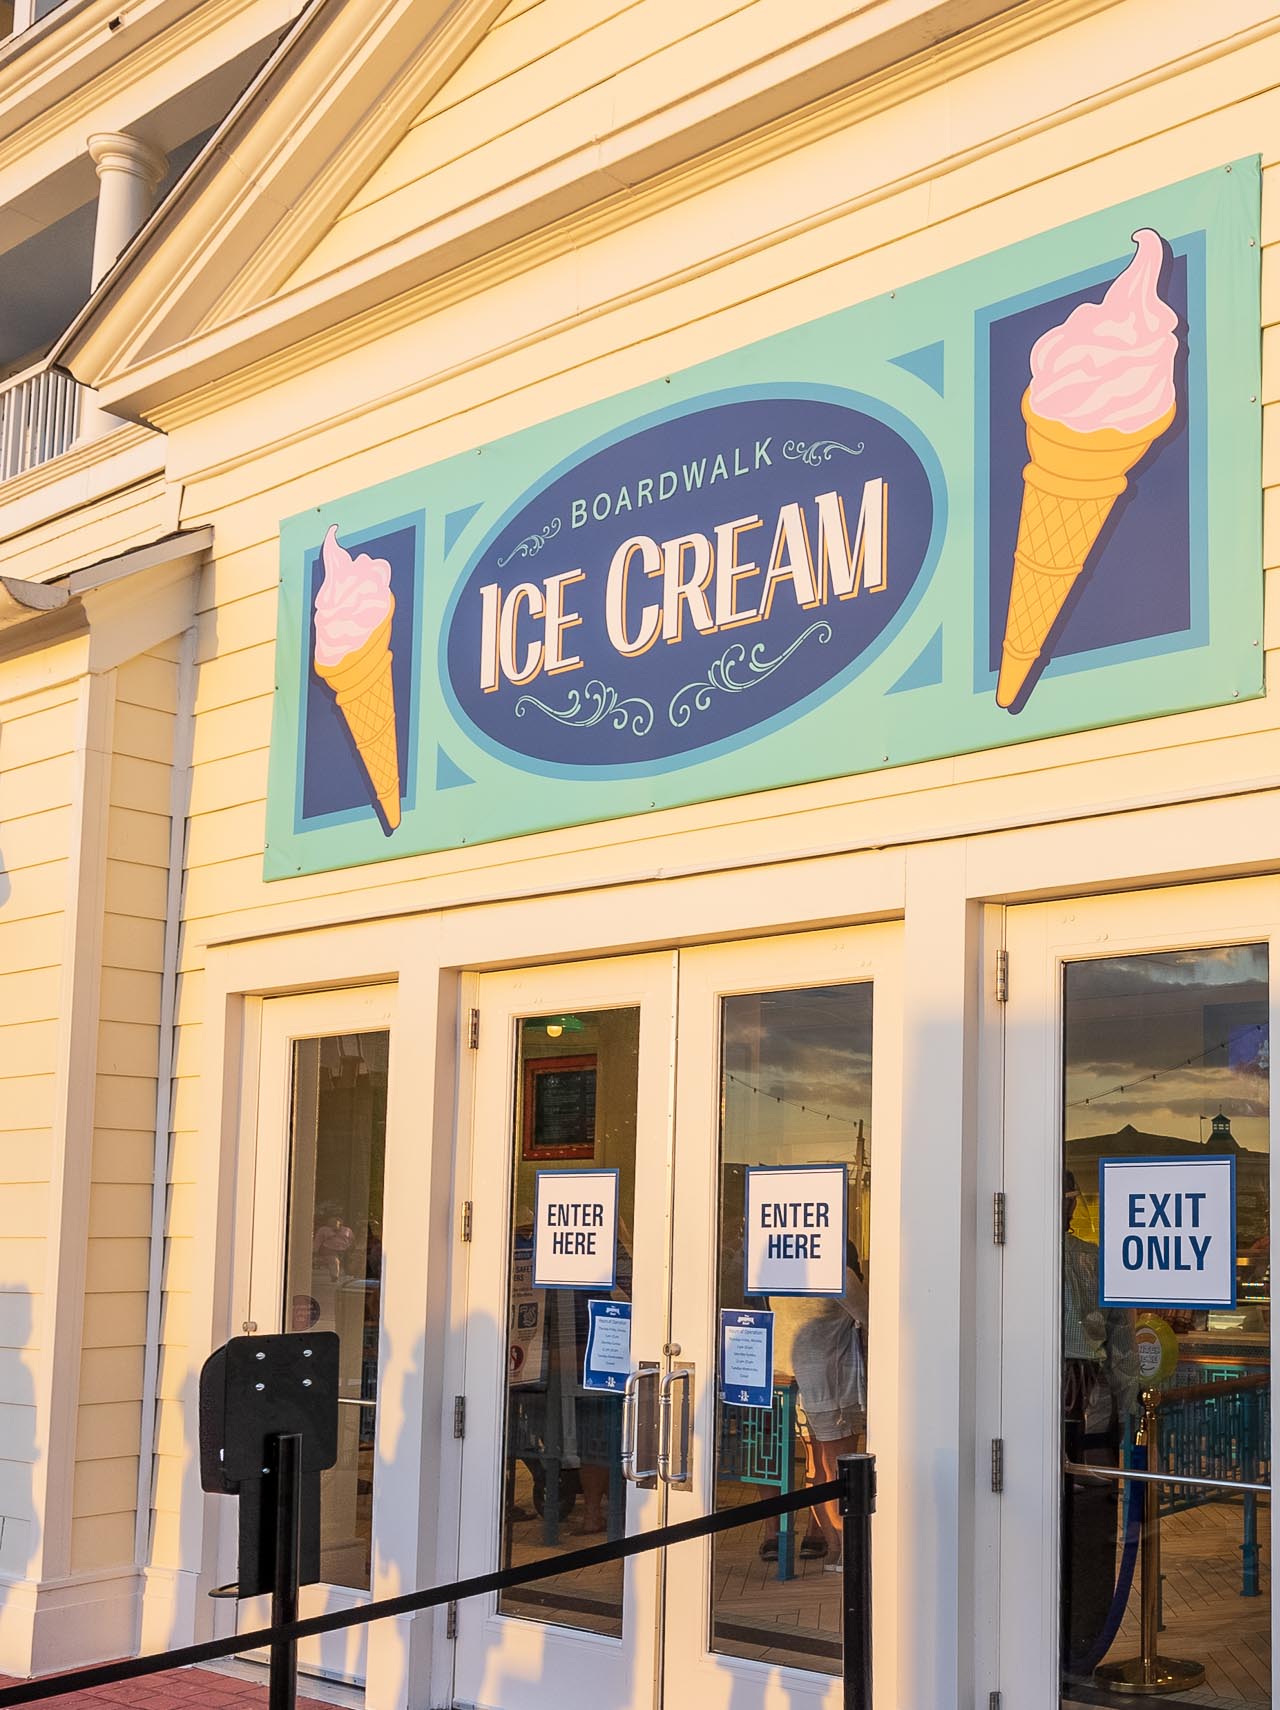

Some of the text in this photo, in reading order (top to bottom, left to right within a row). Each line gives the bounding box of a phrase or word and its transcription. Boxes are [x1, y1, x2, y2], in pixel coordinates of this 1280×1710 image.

[570, 437, 774, 529] BOARDWALK
[479, 477, 889, 694] ICE CREAM
[547, 1203, 604, 1227] ENTER
[760, 1202, 830, 1229] ENTER
[1128, 1192, 1207, 1229] EXIT
[552, 1231, 597, 1255] HERE
[767, 1233, 822, 1260] HERE
[1121, 1234, 1213, 1271] ONLY
